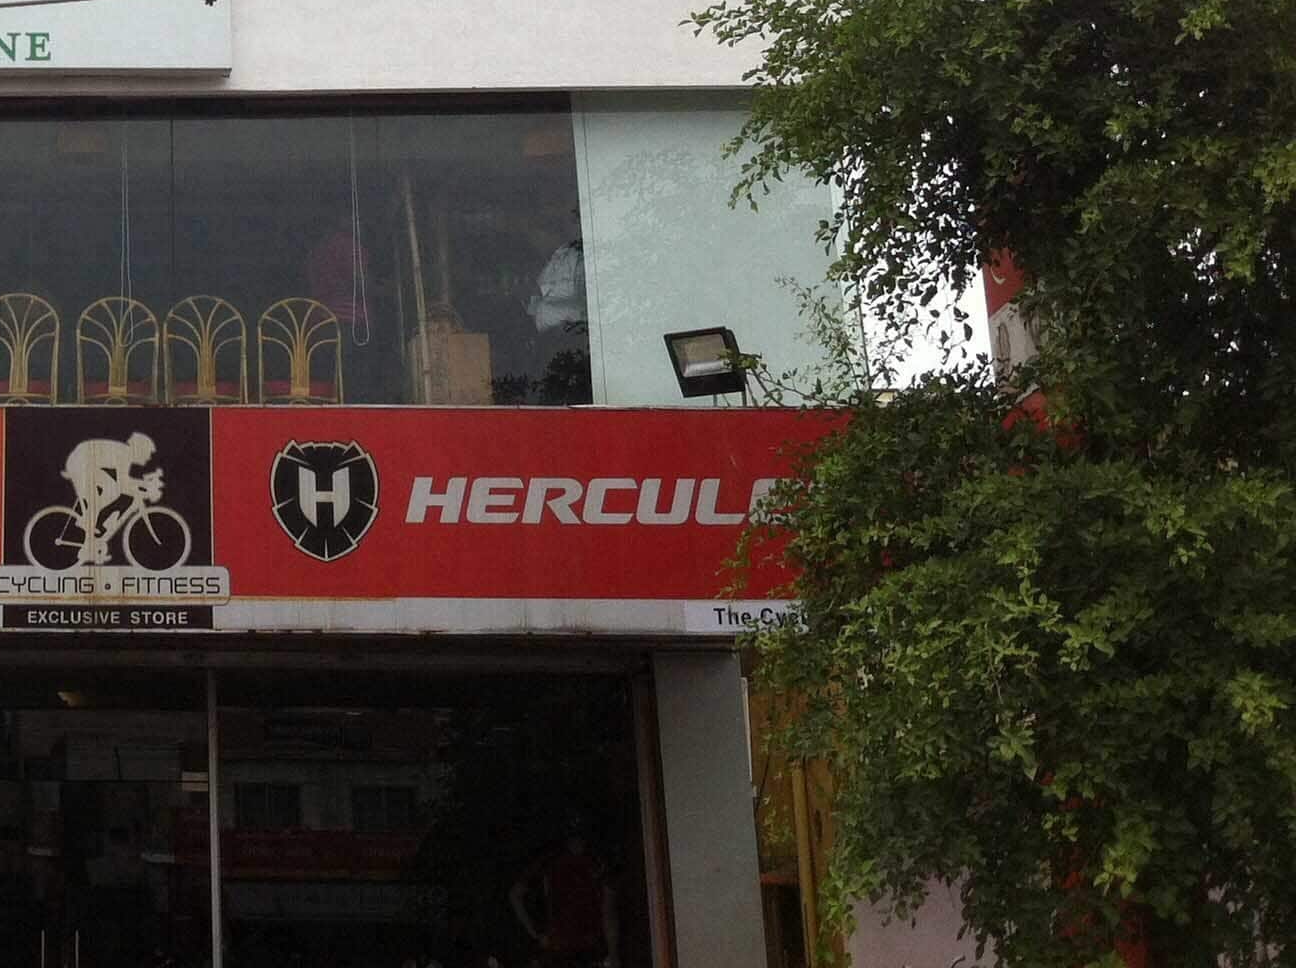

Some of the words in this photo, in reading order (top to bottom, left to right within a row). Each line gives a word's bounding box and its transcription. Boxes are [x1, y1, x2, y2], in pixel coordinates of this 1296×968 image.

[298, 466, 351, 528] H
[121, 576, 221, 594] FITNESS
[27, 610, 121, 625] EXCLUSIVE
[130, 610, 189, 625] STORE
[713, 605, 752, 625] The
